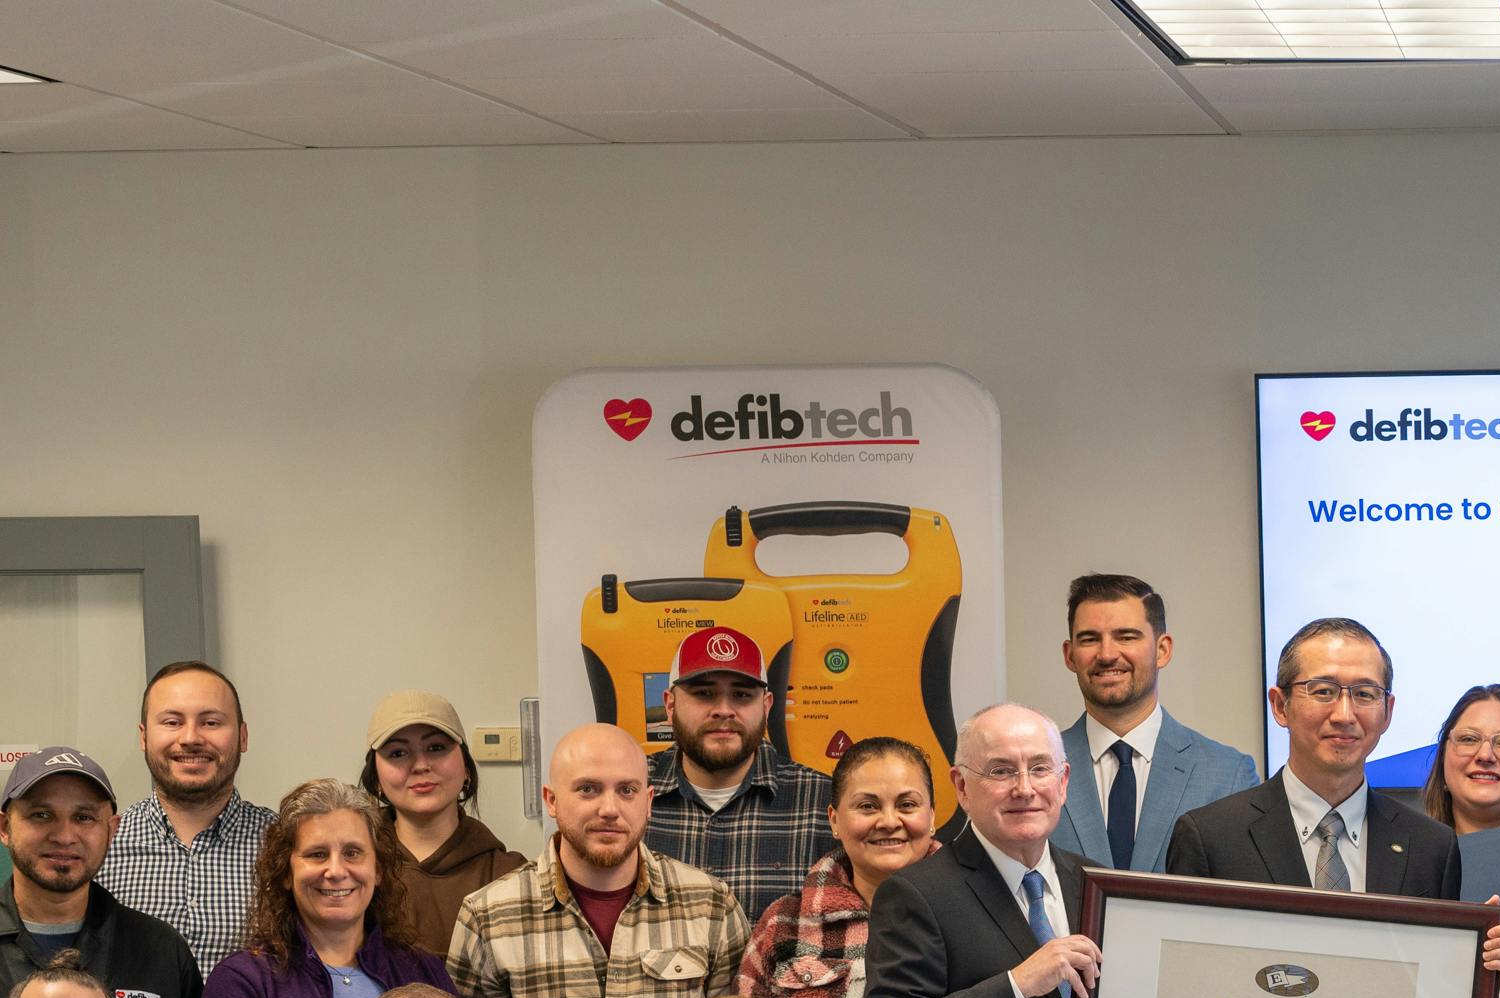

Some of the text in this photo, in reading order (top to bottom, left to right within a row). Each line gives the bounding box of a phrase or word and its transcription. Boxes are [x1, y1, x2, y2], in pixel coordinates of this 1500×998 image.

[670, 390, 913, 442] defibtech
[761, 450, 914, 465] A Nihon Kohden Company
[1308, 498, 1453, 522] Welcome
[1462, 499, 1491, 521] to
[657, 618, 694, 628] Lifeline
[804, 611, 845, 622] Lifeline
[1272, 973, 1283, 985] E
